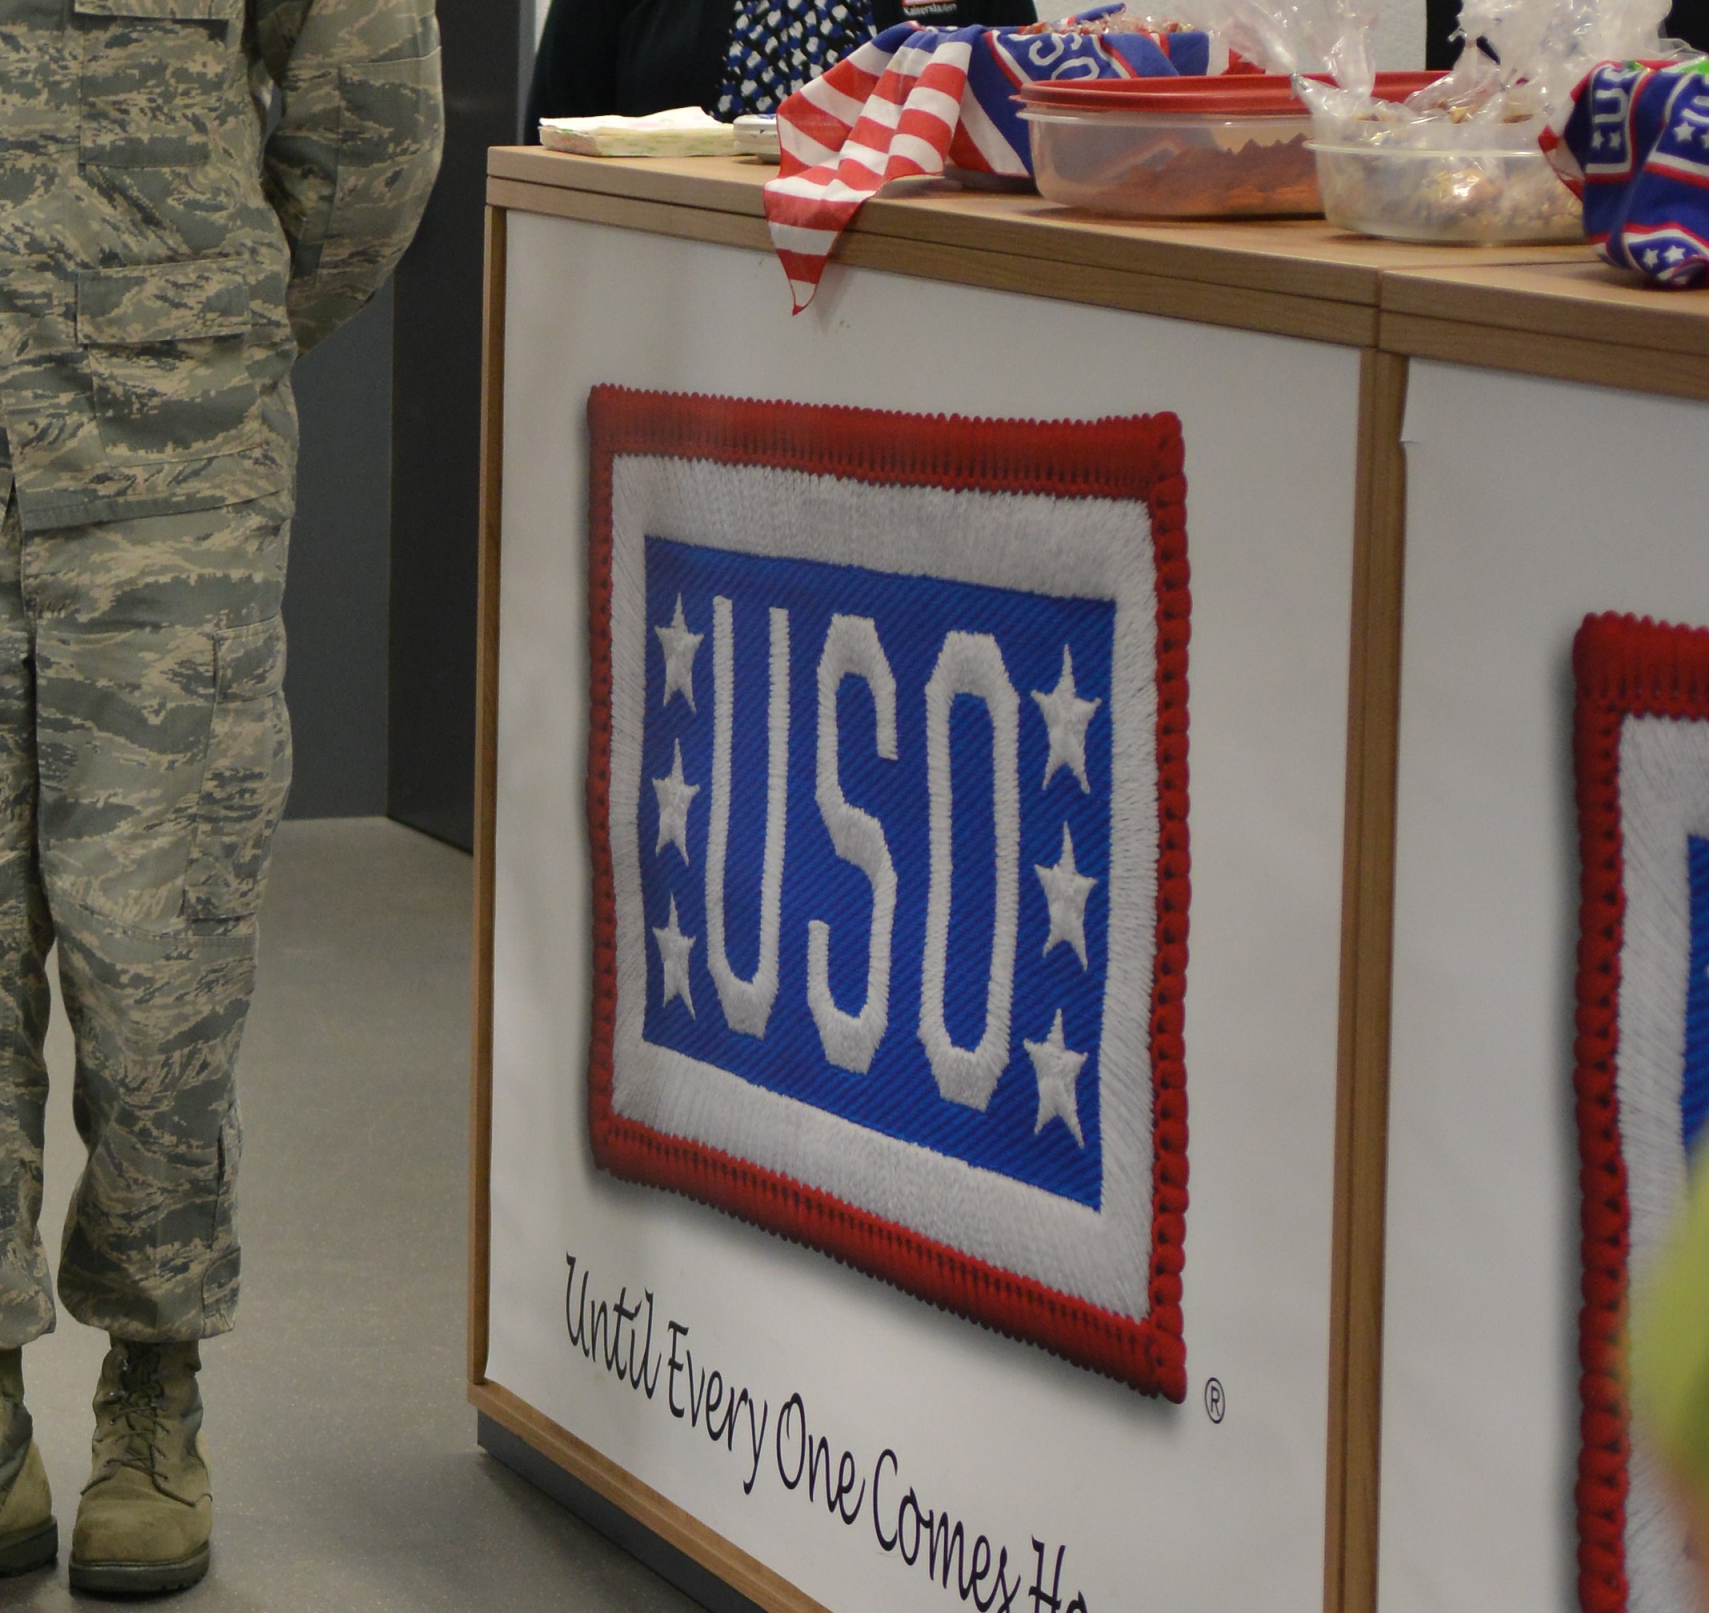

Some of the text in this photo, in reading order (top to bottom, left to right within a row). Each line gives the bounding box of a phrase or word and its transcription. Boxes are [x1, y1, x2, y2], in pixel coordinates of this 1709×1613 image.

[704, 593, 1022, 1113] USO
[565, 1250, 661, 1399] Until
[667, 1319, 768, 1496] Every
[776, 1391, 866, 1526] One
